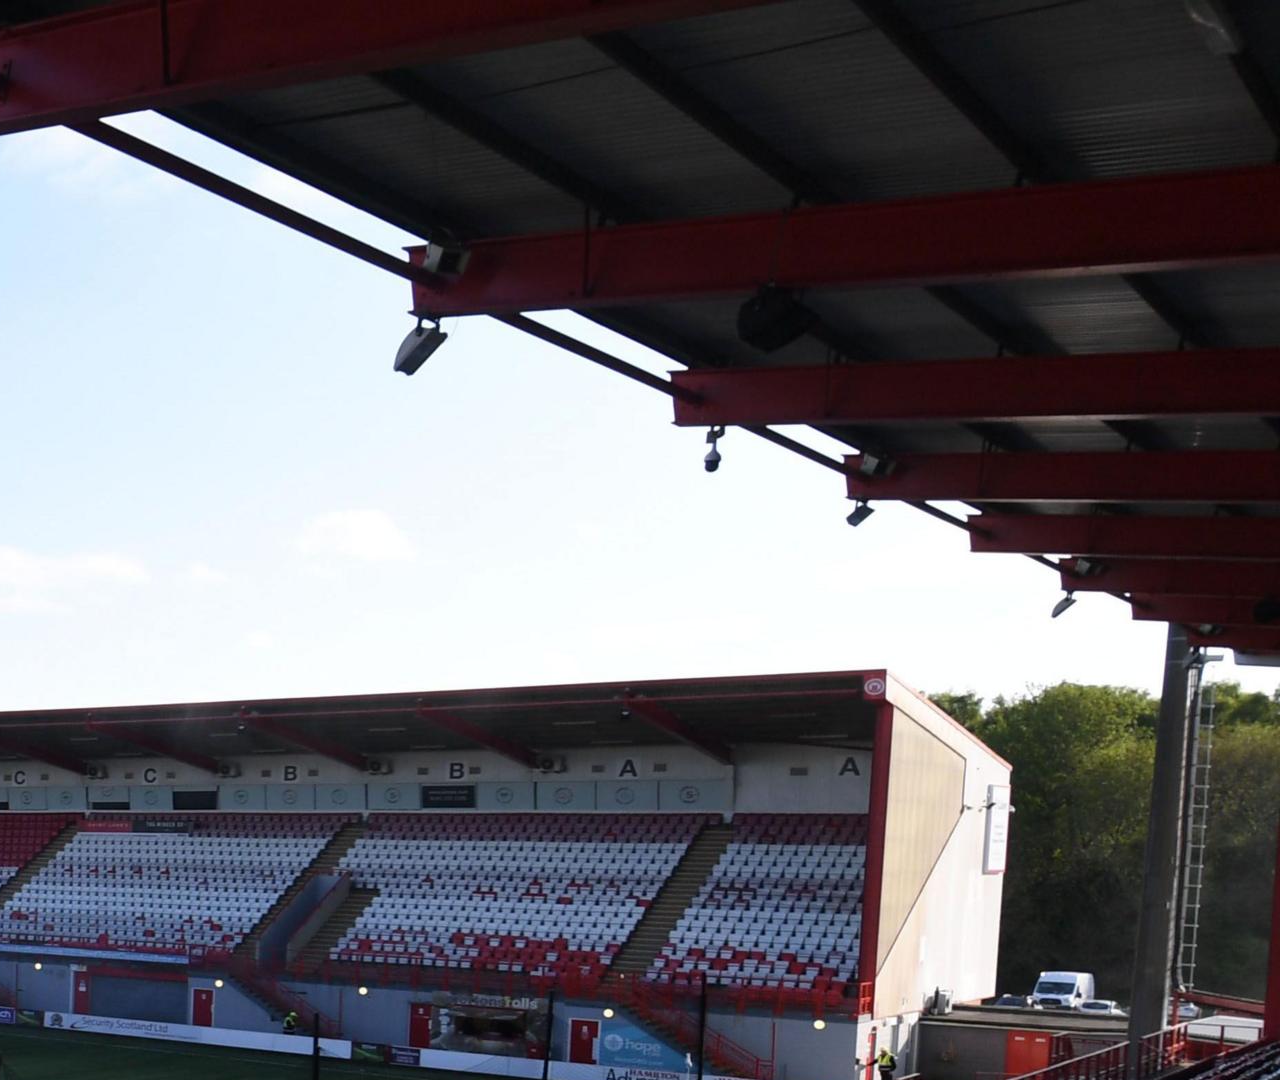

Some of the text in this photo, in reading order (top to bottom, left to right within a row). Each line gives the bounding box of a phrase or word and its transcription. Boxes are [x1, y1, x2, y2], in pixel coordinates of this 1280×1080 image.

[284, 766, 297, 781] B
[449, 762, 465, 779] B
[619, 760, 638, 777] A
[839, 757, 860, 776] A
[13, 771, 26, 785] C
[144, 768, 157, 783] C
[504, 996, 538, 1010] rolls
[81, 1016, 168, 1034] Security Scotland Ltd
[629, 1069, 680, 1080] HAMILTON
